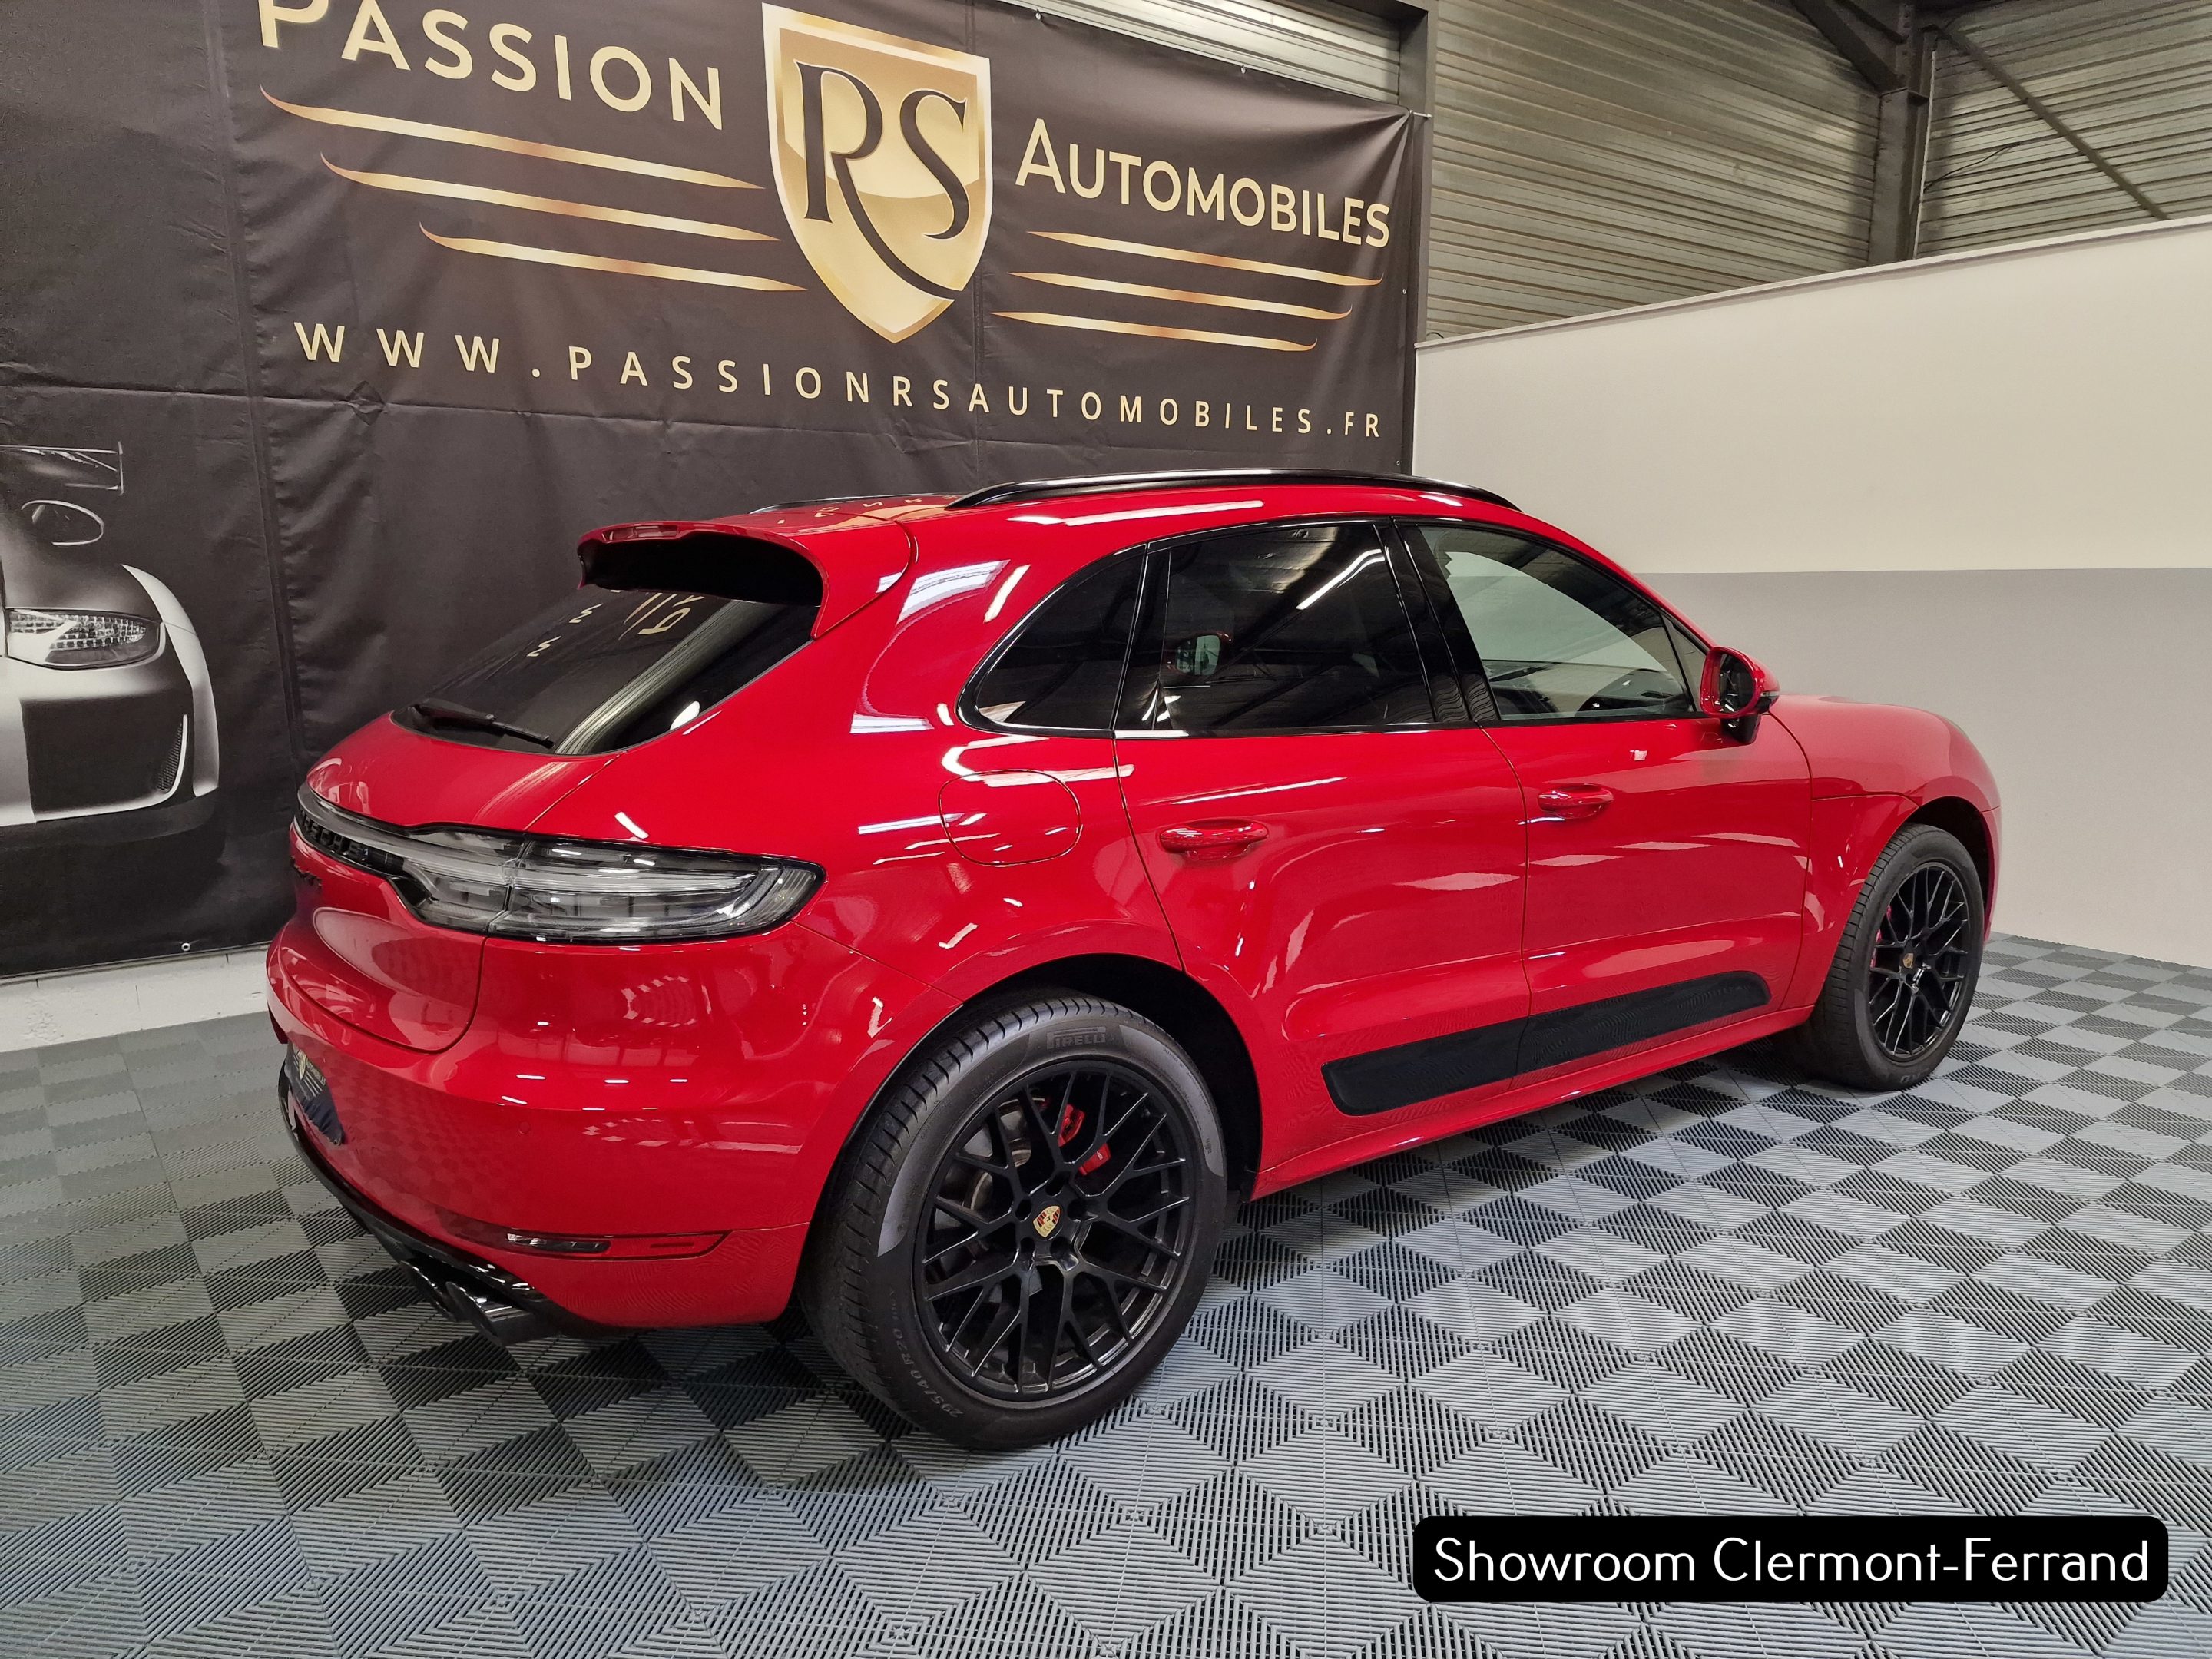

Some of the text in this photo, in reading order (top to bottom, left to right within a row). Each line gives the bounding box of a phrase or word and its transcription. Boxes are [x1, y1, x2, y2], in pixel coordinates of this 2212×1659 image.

[258, 0, 1390, 301] PASSION RS AUTOMOBILES
[293, 322, 1379, 438] WWW.PASSIONRSAUTOMOBILES.FR
[1046, 1026, 1106, 1050] PIRELLI
